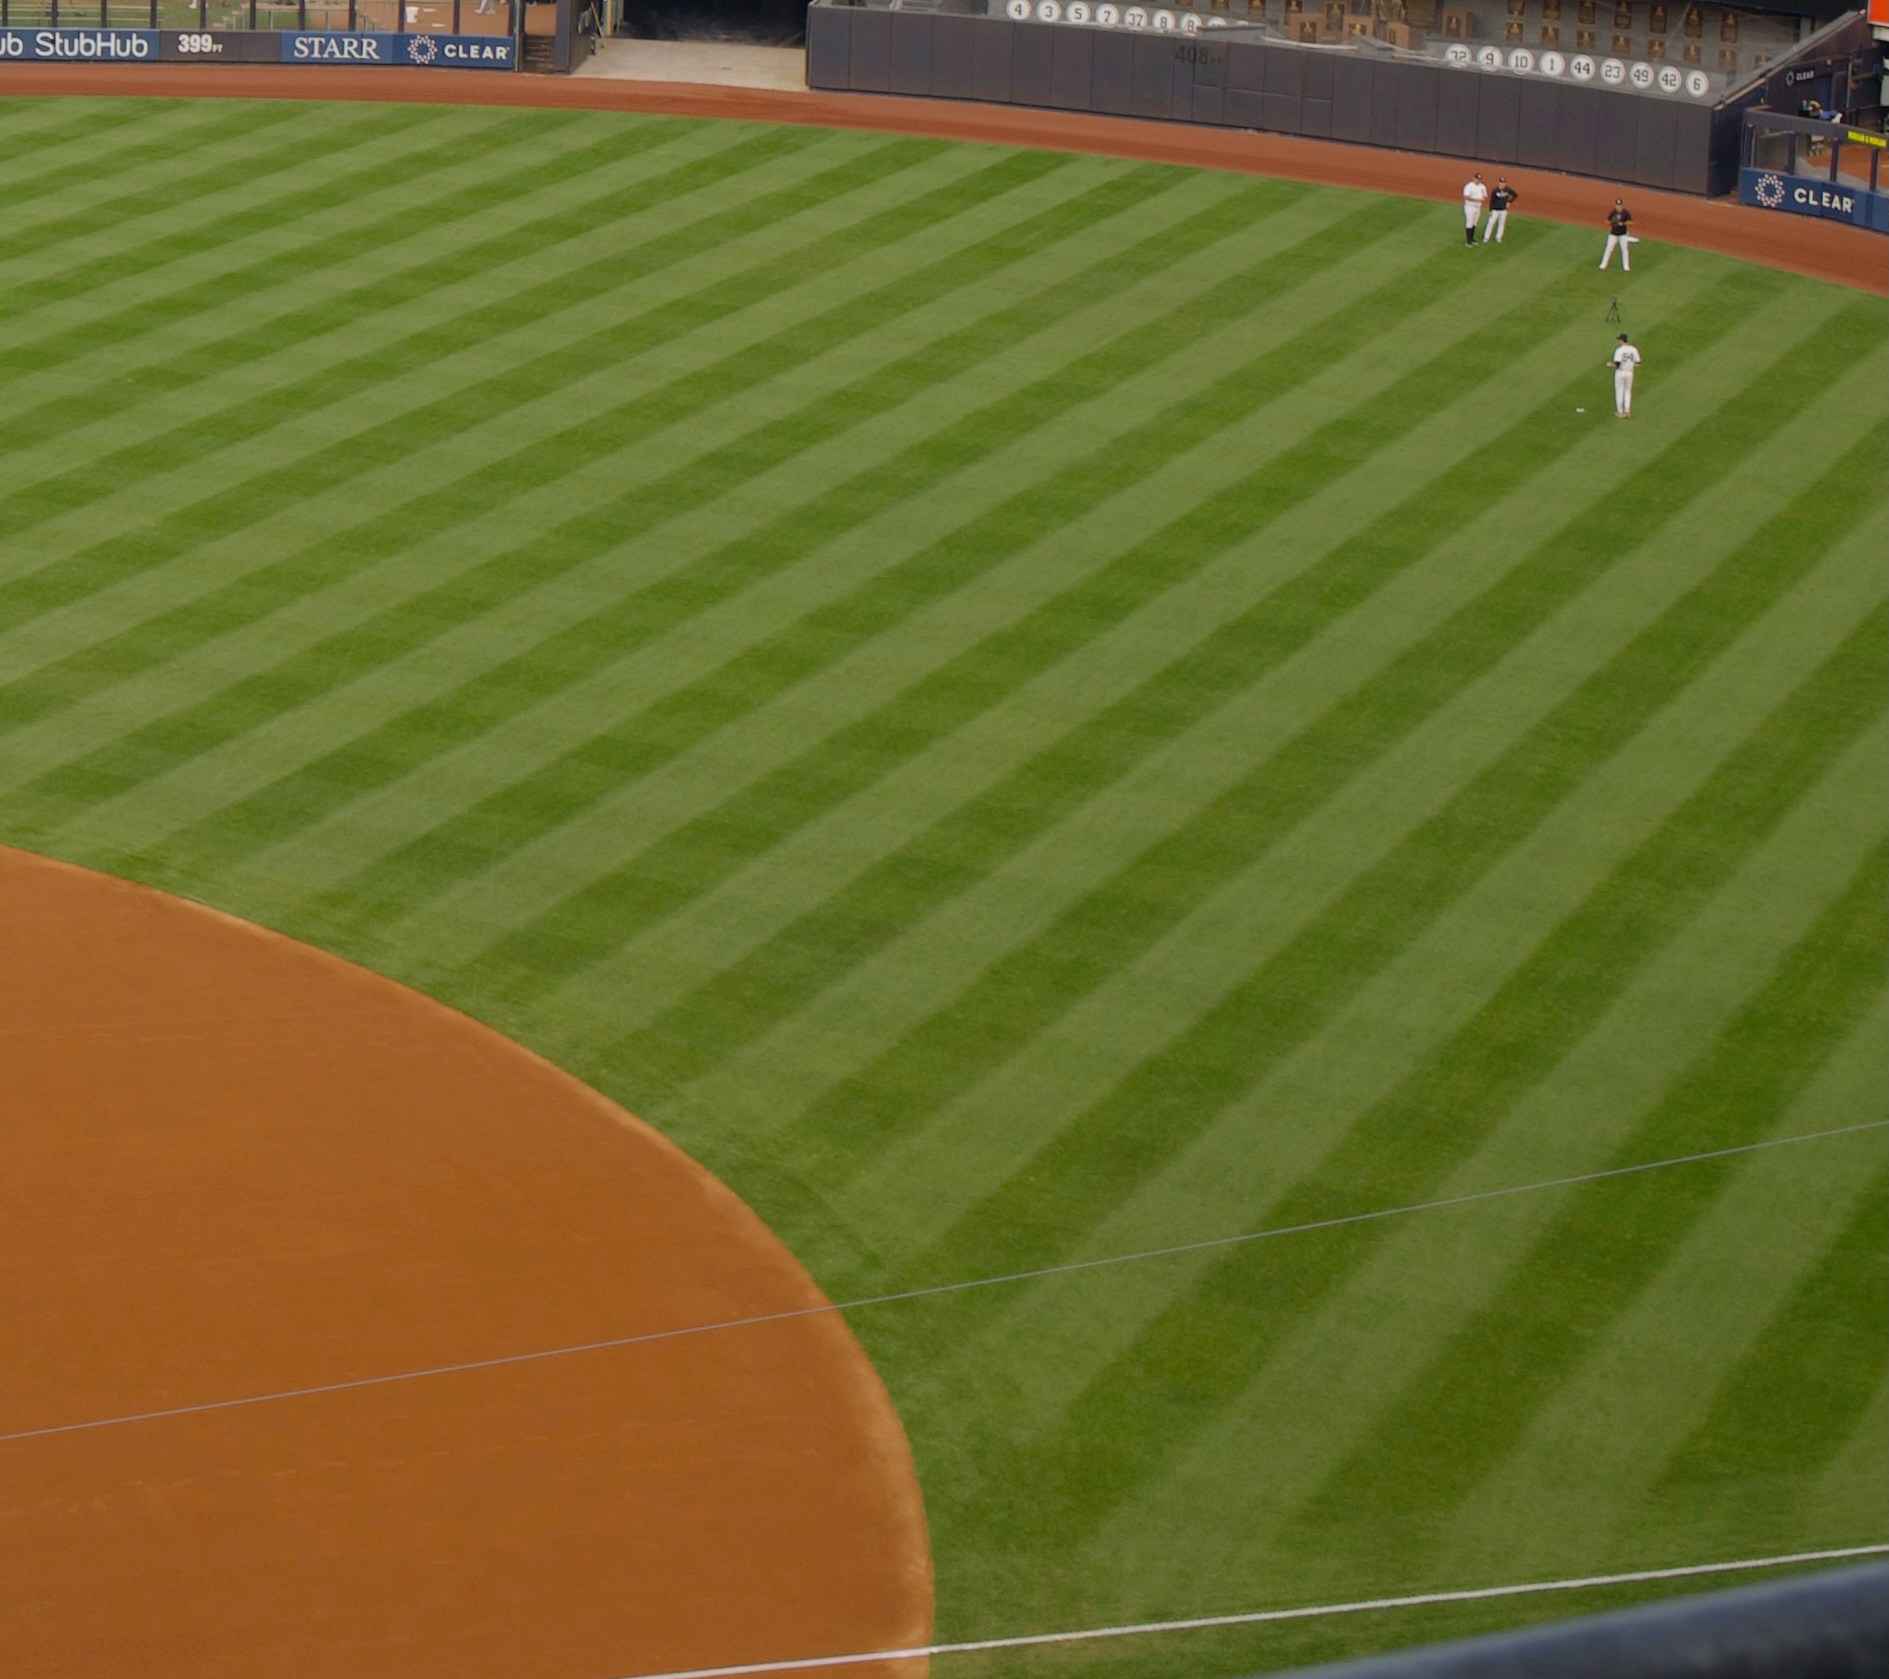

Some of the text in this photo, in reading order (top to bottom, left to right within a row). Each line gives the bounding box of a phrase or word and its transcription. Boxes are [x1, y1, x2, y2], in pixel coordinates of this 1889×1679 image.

[35, 31, 148, 58] StubHub
[178, 35, 212, 52] 399
[294, 37, 379, 59] STARR
[444, 45, 507, 60] CLEAR
[1176, 46, 1208, 65] 408
[1794, 188, 1852, 213] CLEAR
